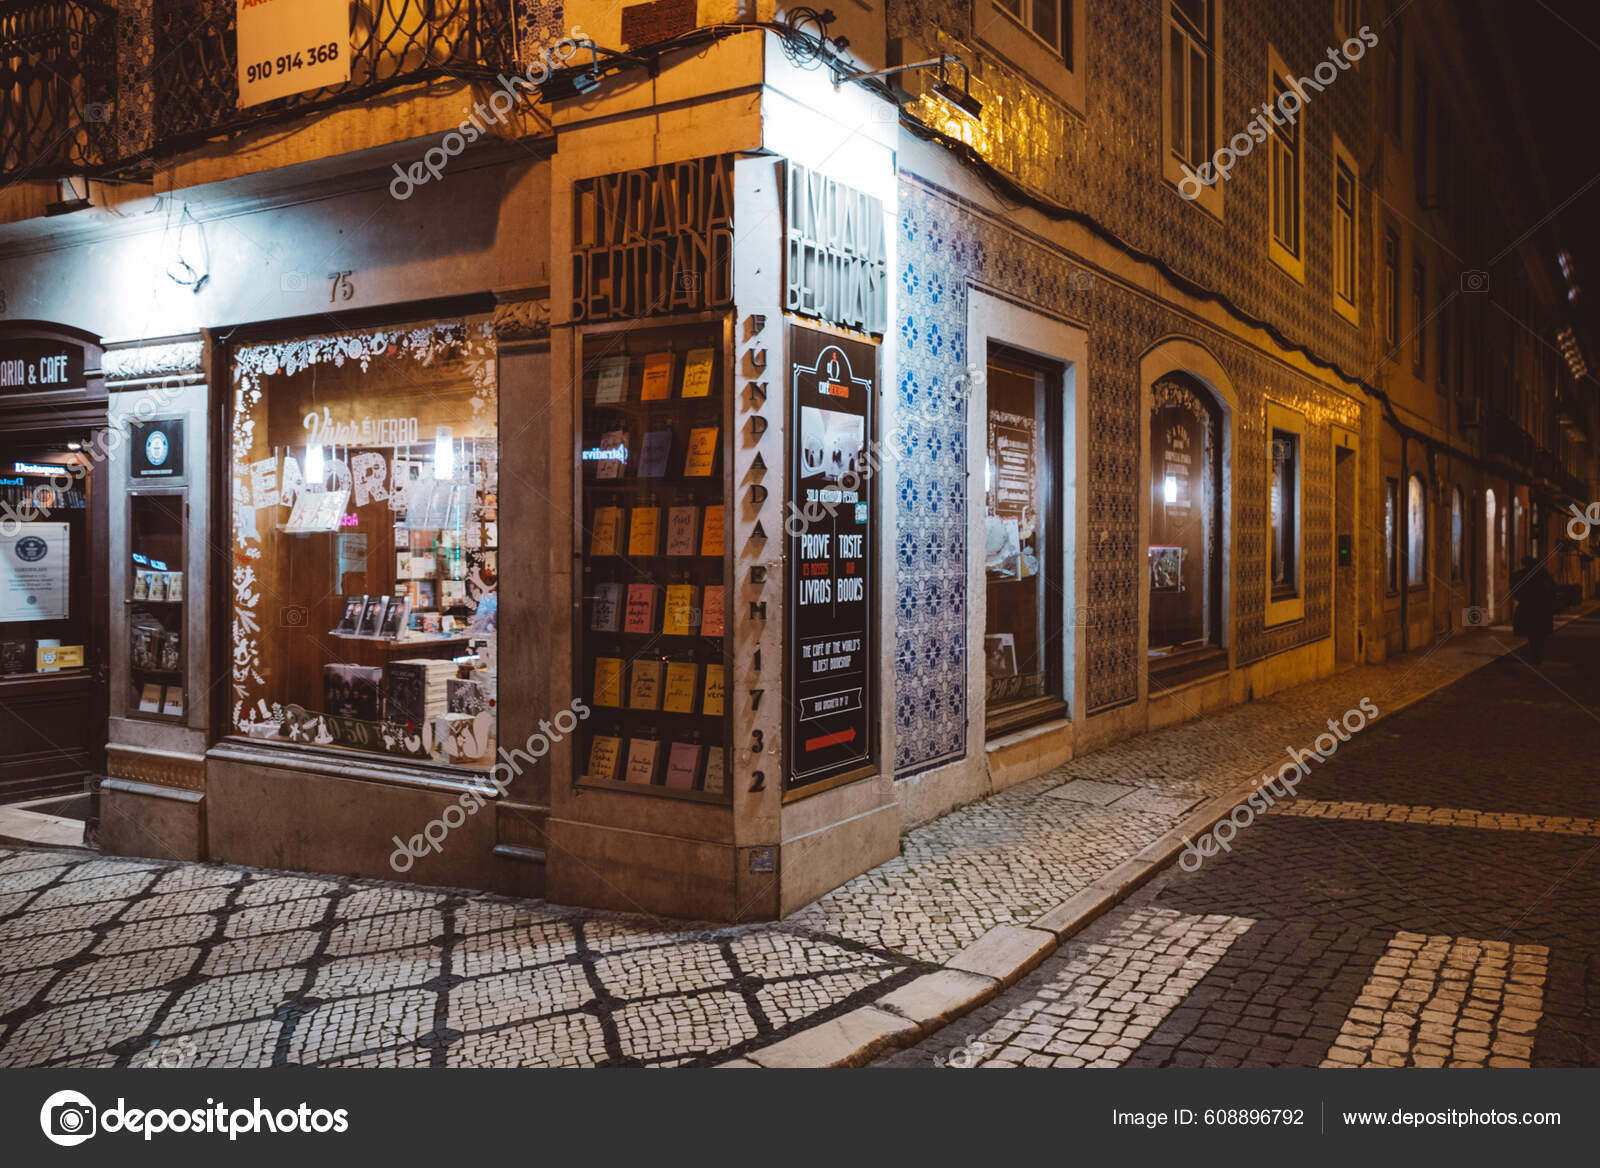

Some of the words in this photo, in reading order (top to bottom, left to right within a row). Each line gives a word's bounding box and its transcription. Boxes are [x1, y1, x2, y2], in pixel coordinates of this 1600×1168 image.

[247, 60, 272, 83] 910
[276, 51, 303, 75] 914
[306, 42, 338, 66] 368
[328, 270, 354, 302] 75
[572, 227, 735, 323] BERTRAND
[28, 363, 37, 385] &
[371, 417, 419, 446] VERBO
[747, 314, 769, 539] FUNDADA
[801, 533, 830, 560] PROVE
[838, 534, 863, 559] TASTE
[799, 578, 832, 606] LIVROS
[837, 577, 864, 602] BOOKS
[747, 642, 767, 793] 1732
